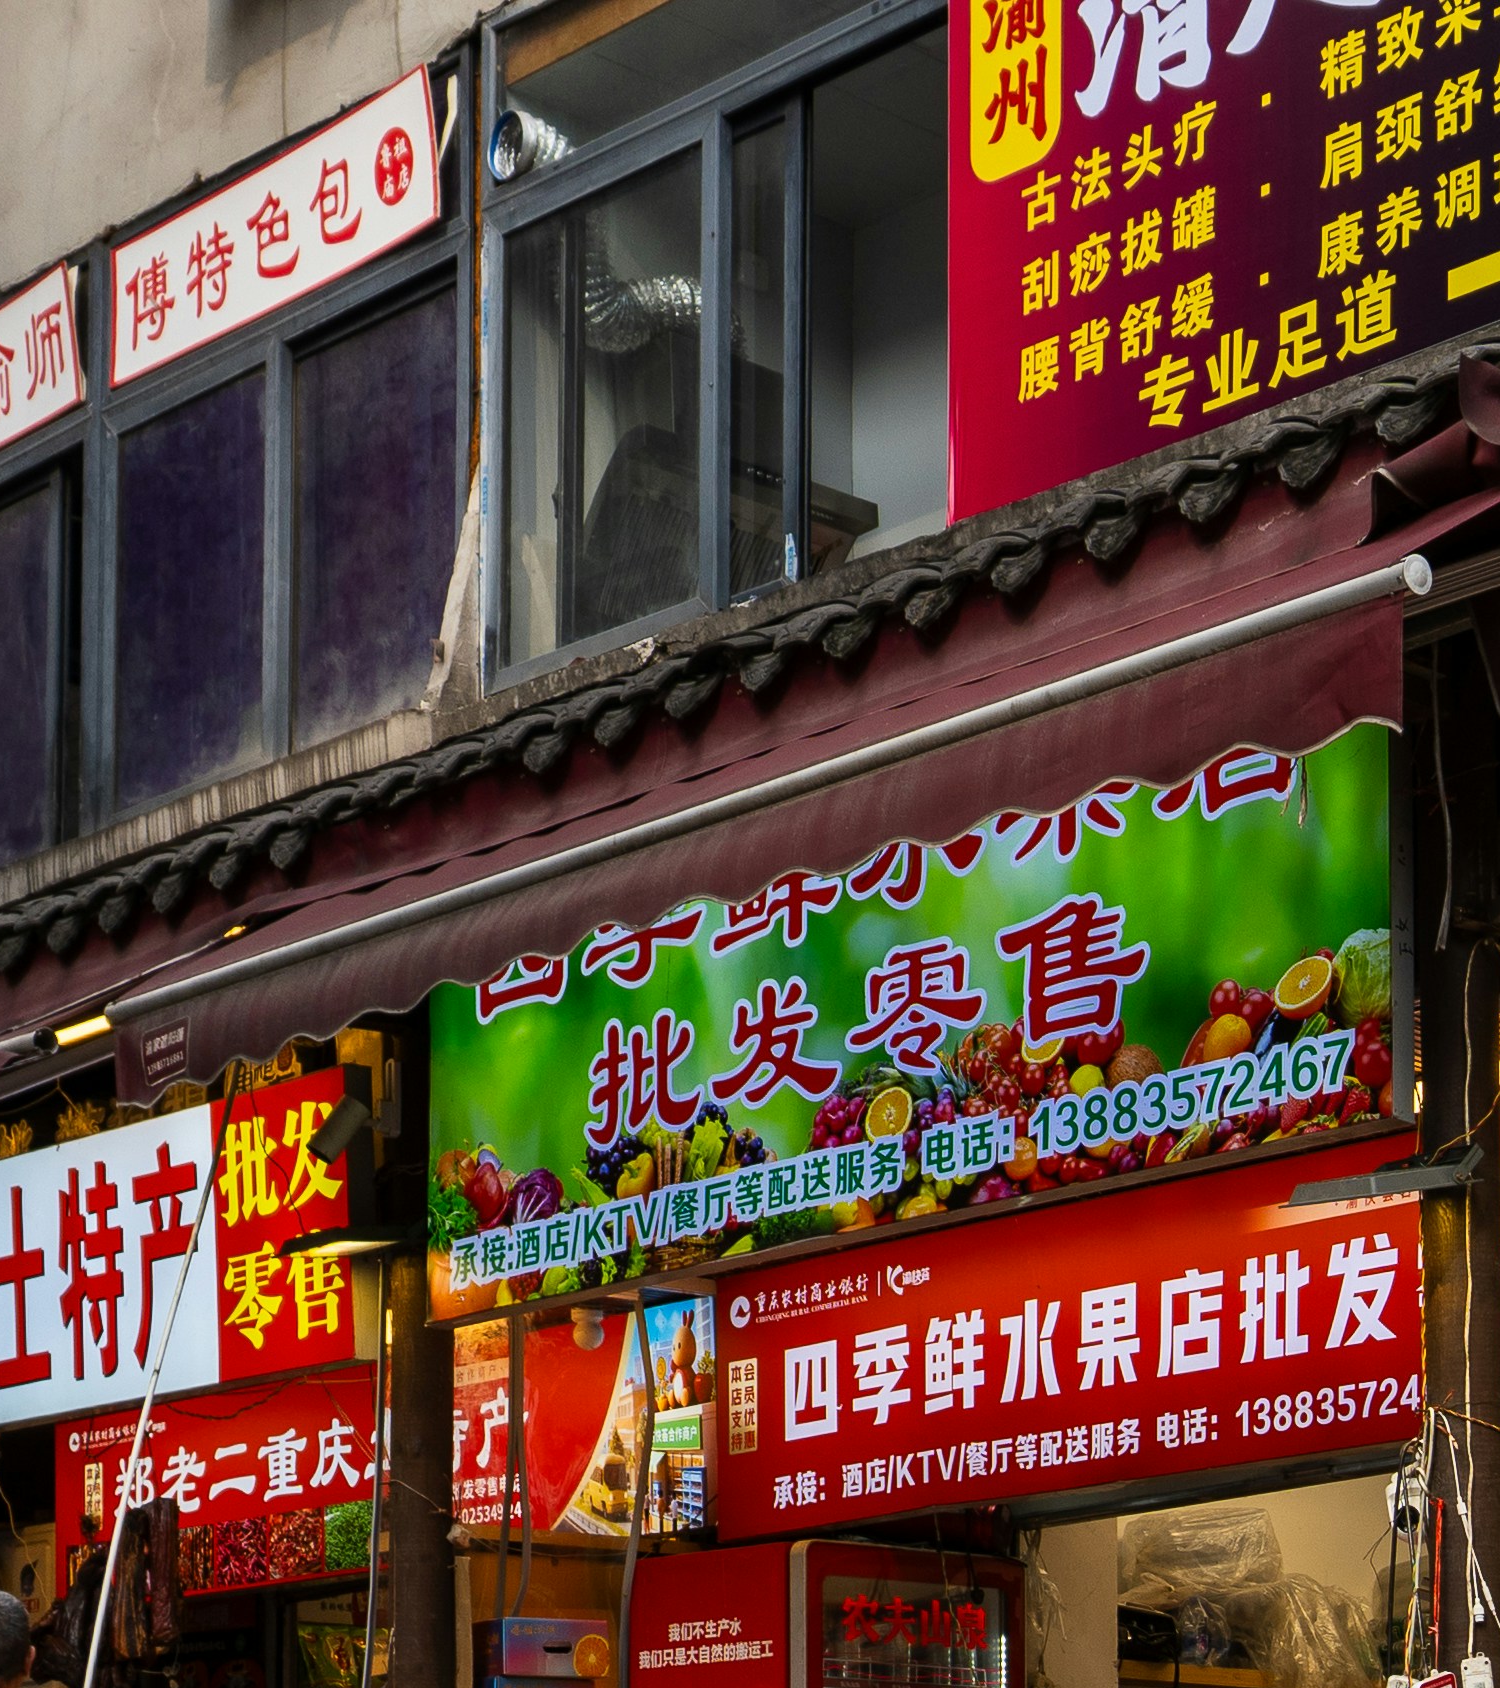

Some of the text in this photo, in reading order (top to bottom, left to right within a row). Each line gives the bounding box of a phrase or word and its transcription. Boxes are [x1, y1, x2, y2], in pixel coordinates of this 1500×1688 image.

[1021, 98, 1218, 233] 古法头疗
[1021, 185, 1217, 318] 刮痧拔罐
[1017, 273, 1216, 405] 腰背舒缓
[1138, 268, 1399, 431] 专业足道
[584, 890, 1150, 1150] 批发零售
[217, 1099, 344, 1228] 批发
[222, 1228, 347, 1350] 零售
[638, 1640, 775, 1670] 我们只是大自然的搬运工
[667, 1617, 742, 1642] 我们不生产水
[841, 1593, 989, 1651] 农夫山泉
